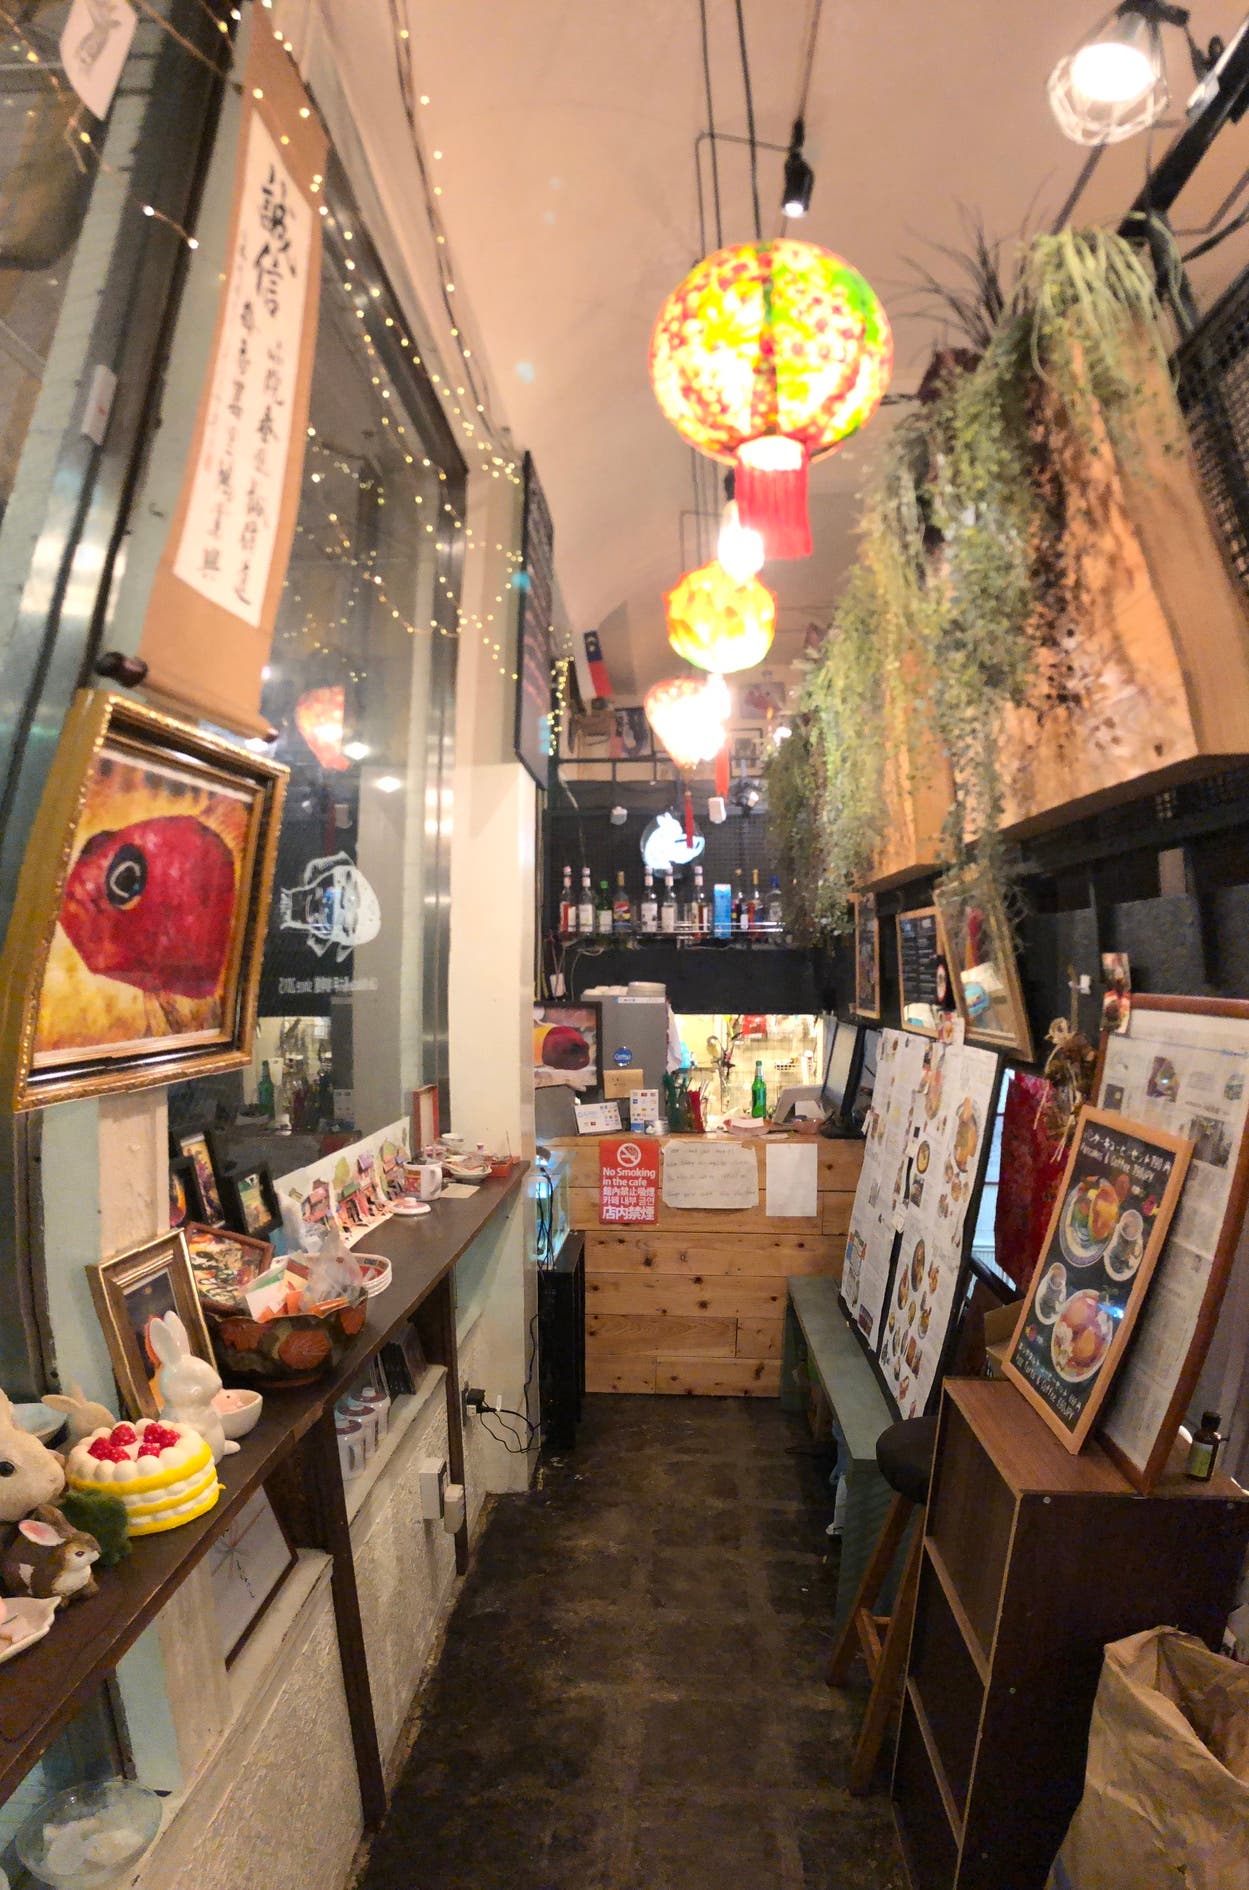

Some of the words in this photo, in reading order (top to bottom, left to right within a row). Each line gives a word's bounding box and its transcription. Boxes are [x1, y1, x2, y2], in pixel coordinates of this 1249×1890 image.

[602, 1167, 616, 1177] No
[617, 1168, 656, 1179] Smoking
[602, 1177, 611, 1186] in
[613, 1177, 628, 1186] the
[629, 1177, 647, 1186] cafe
